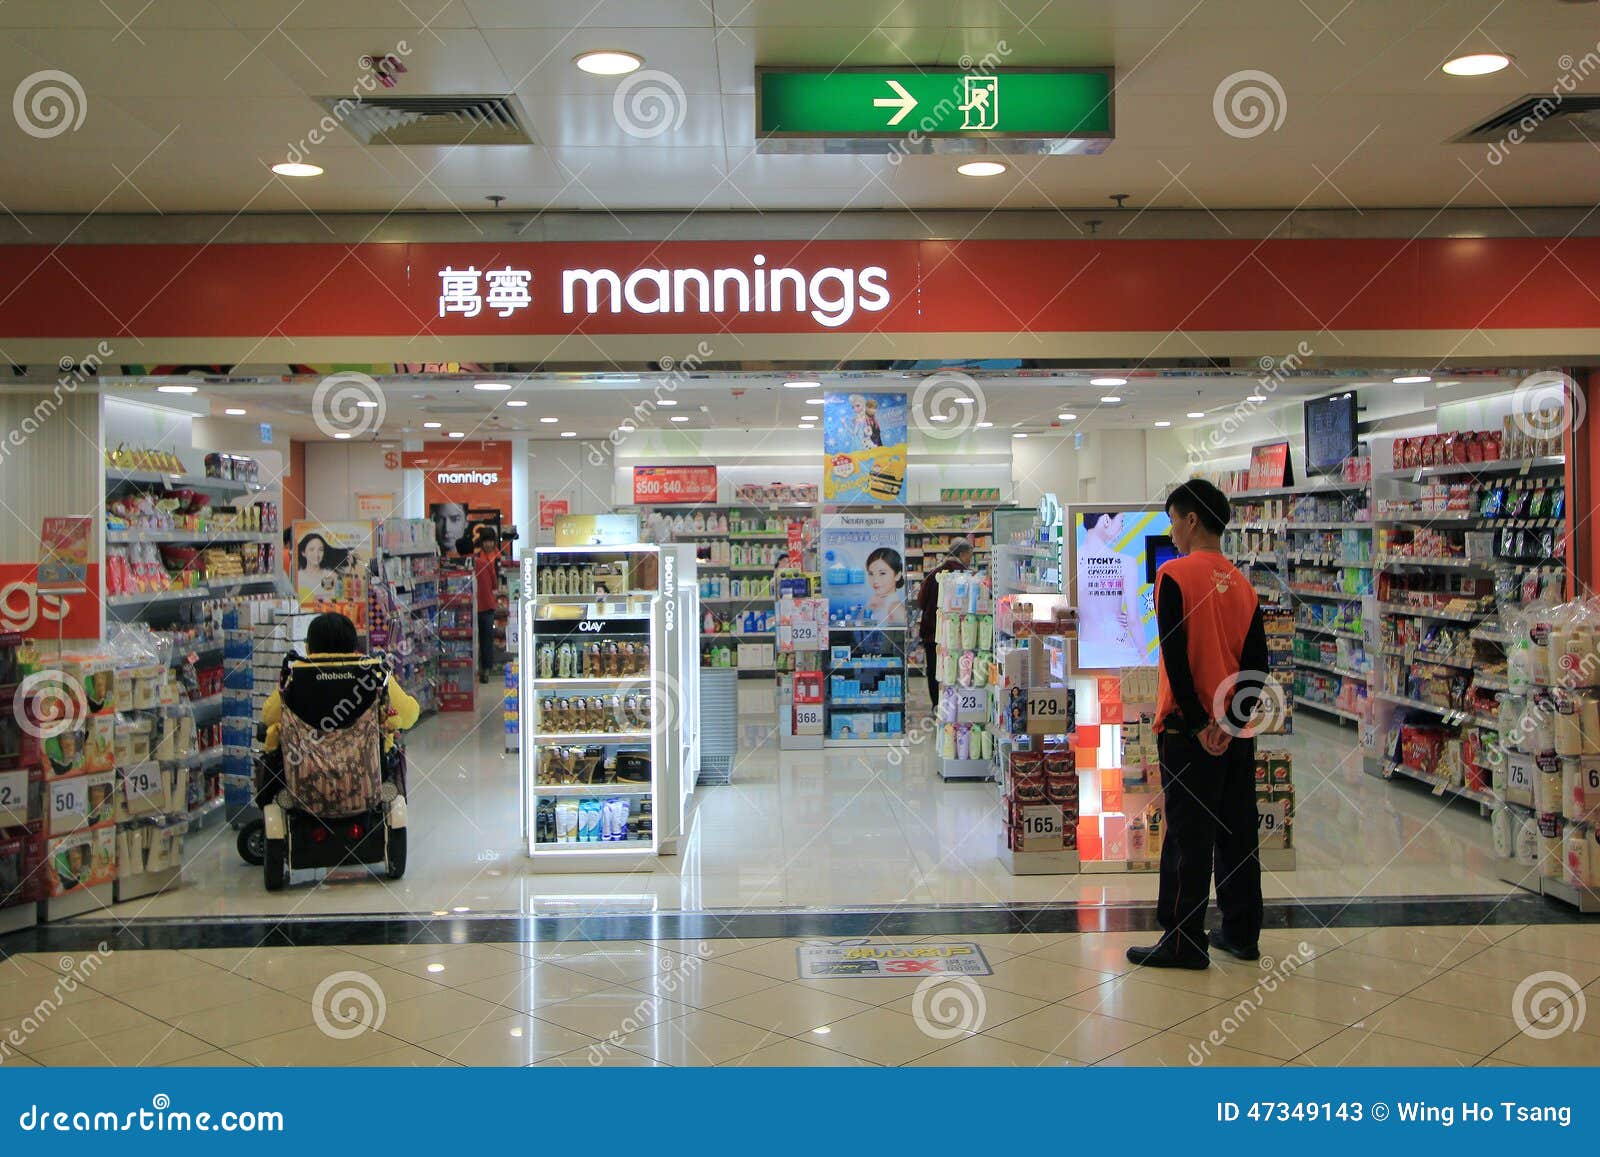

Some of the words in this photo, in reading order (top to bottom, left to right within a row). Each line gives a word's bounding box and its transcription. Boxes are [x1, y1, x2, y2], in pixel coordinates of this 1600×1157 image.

[438, 264, 532, 318] 萬寧
[562, 254, 890, 327] mannings
[437, 471, 498, 486] mannings
[664, 556, 675, 598] Beauty
[1088, 557, 1113, 565] ITCHY
[664, 600, 675, 631] Care
